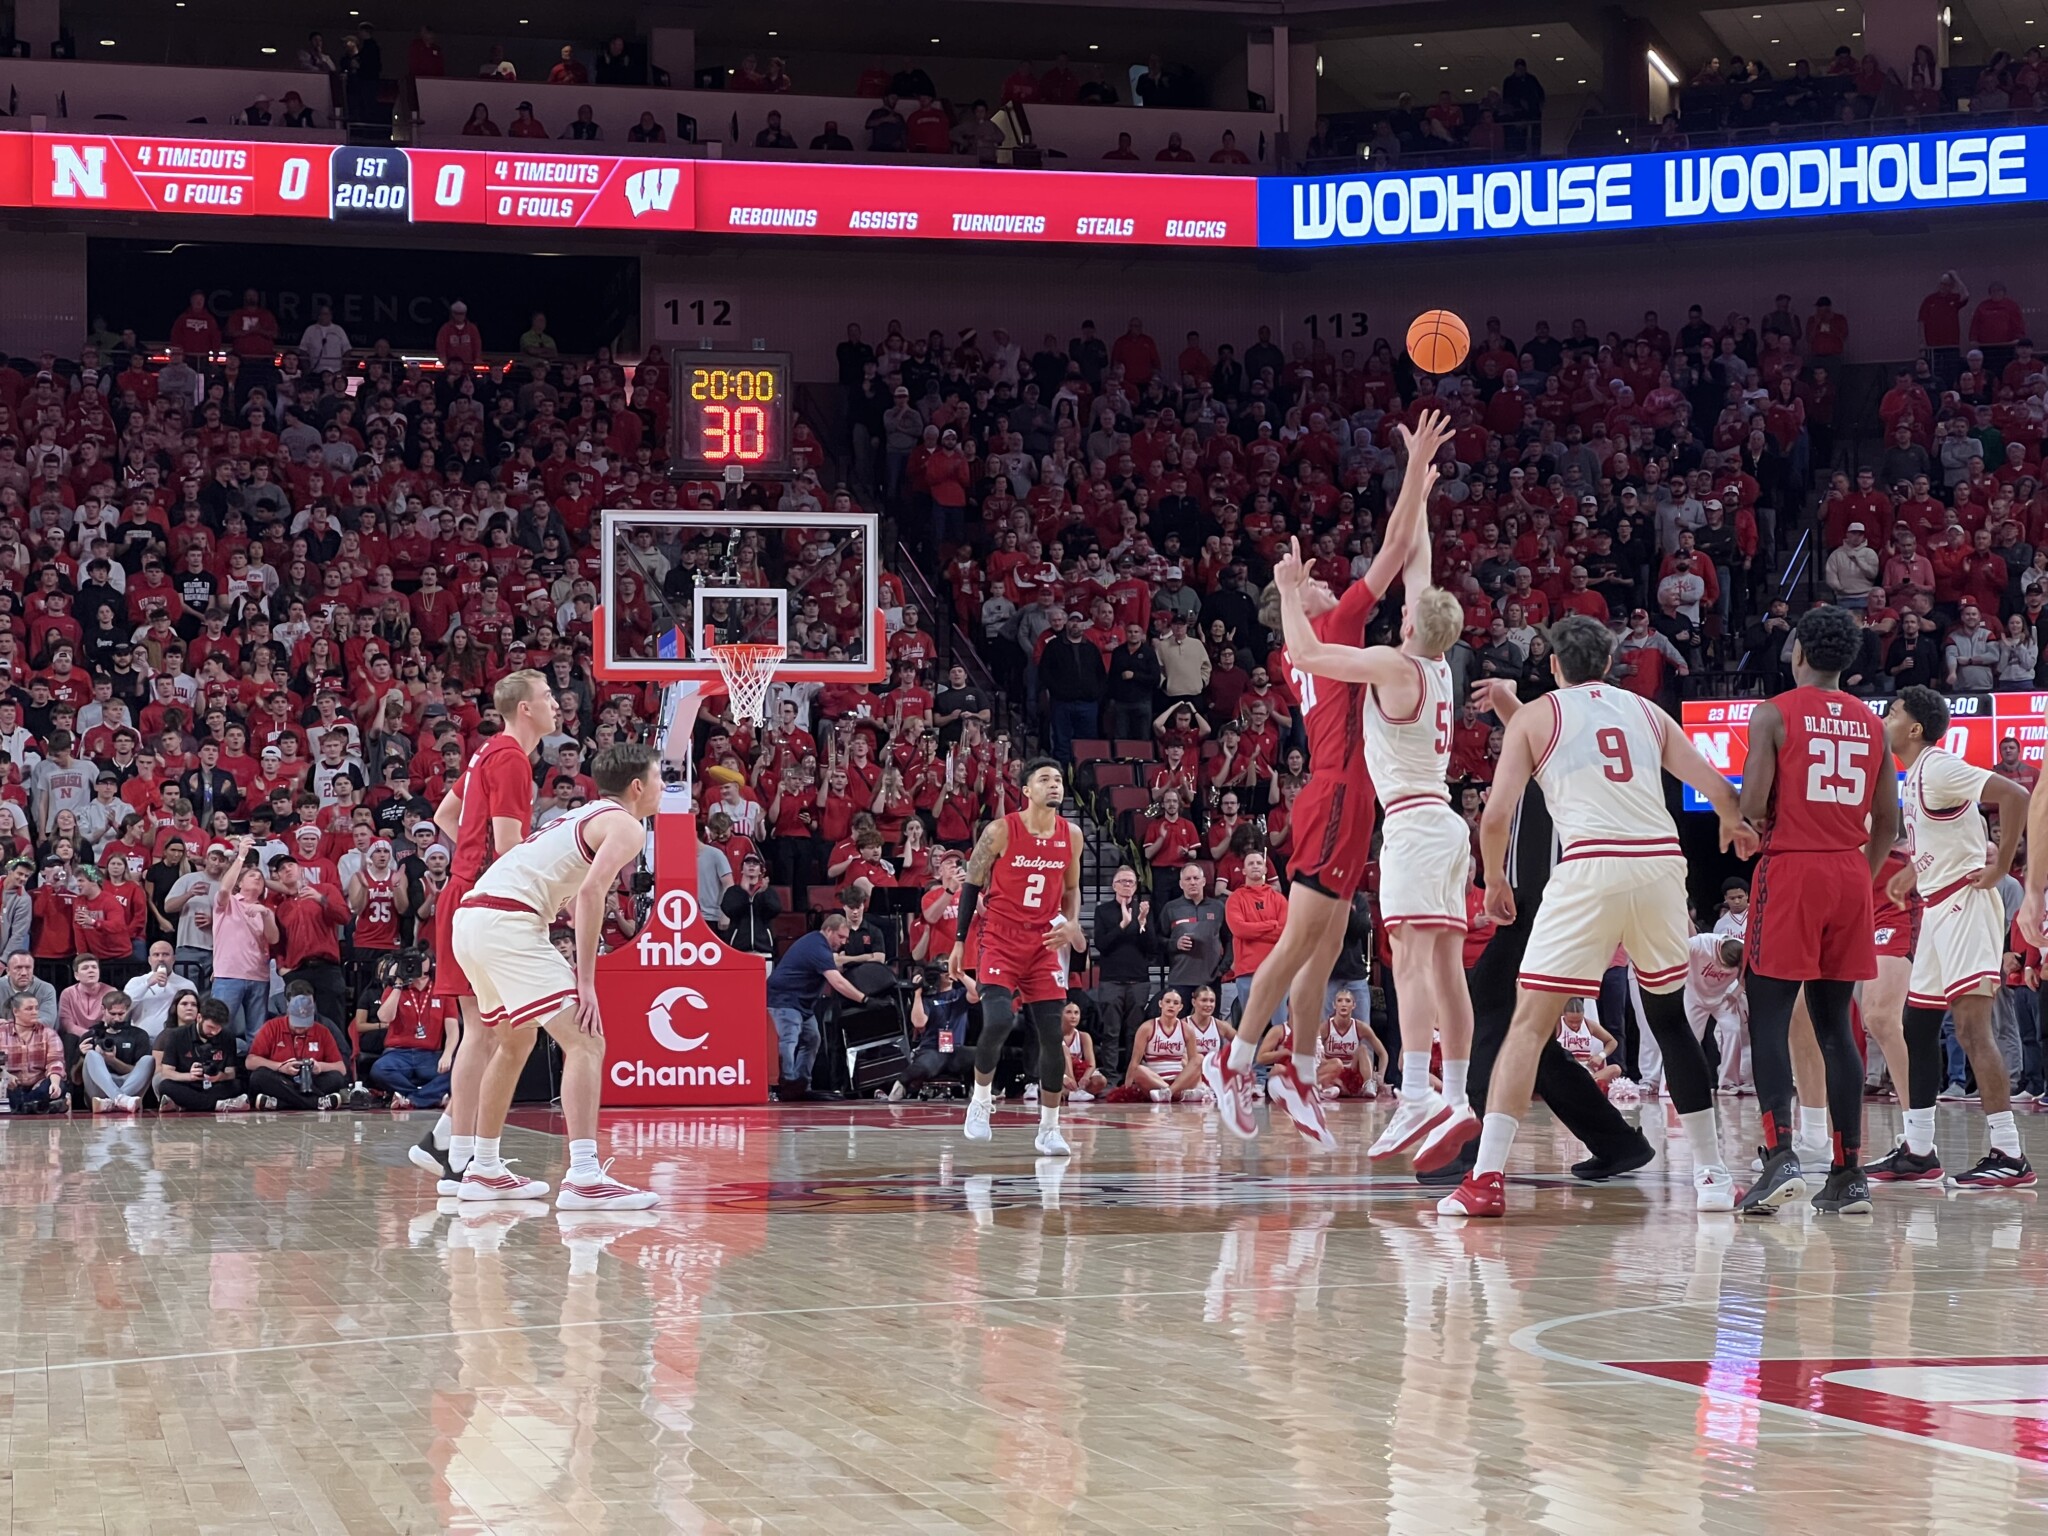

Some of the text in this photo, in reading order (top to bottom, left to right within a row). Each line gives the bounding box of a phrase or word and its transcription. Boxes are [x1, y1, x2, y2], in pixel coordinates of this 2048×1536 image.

[51, 144, 107, 199] N
[137, 146, 248, 170] 4 TIMEOUTS
[355, 157, 389, 178] 1ST
[494, 160, 600, 184] 4 TIMEOUTS
[163, 183, 243, 205] 0 FOULS
[278, 157, 311, 201] 0
[435, 164, 465, 207] 0
[624, 167, 681, 218] W
[1293, 134, 2027, 240] WOODHOUSE WOODHOUSE
[335, 183, 406, 210] 20:00
[497, 196, 574, 218] 0 FOULS
[728, 207, 1227, 239] REBOUNDS ASSISTS TURNOVERS STEALS BLOCKS
[664, 300, 732, 326] 112
[1303, 312, 1369, 341] 113
[691, 370, 773, 401] 20:00
[703, 405, 765, 459] 30
[857, 704, 871, 719] N
[1708, 708, 1725, 722] 23
[1864, 700, 1888, 716] ST
[1944, 697, 1979, 715] :00
[1435, 702, 1452, 755] 5
[1804, 716, 1871, 739] BLACKWELL
[1596, 727, 1634, 783] 9
[1692, 732, 1731, 769] N
[1944, 726, 1969, 760] 0
[1806, 737, 1869, 806] 25
[1011, 855, 1065, 871] Badgers
[1022, 873, 1046, 908] 2
[368, 901, 392, 923] 35
[636, 932, 722, 966] fnbo
[610, 1058, 752, 1088] Channel.
